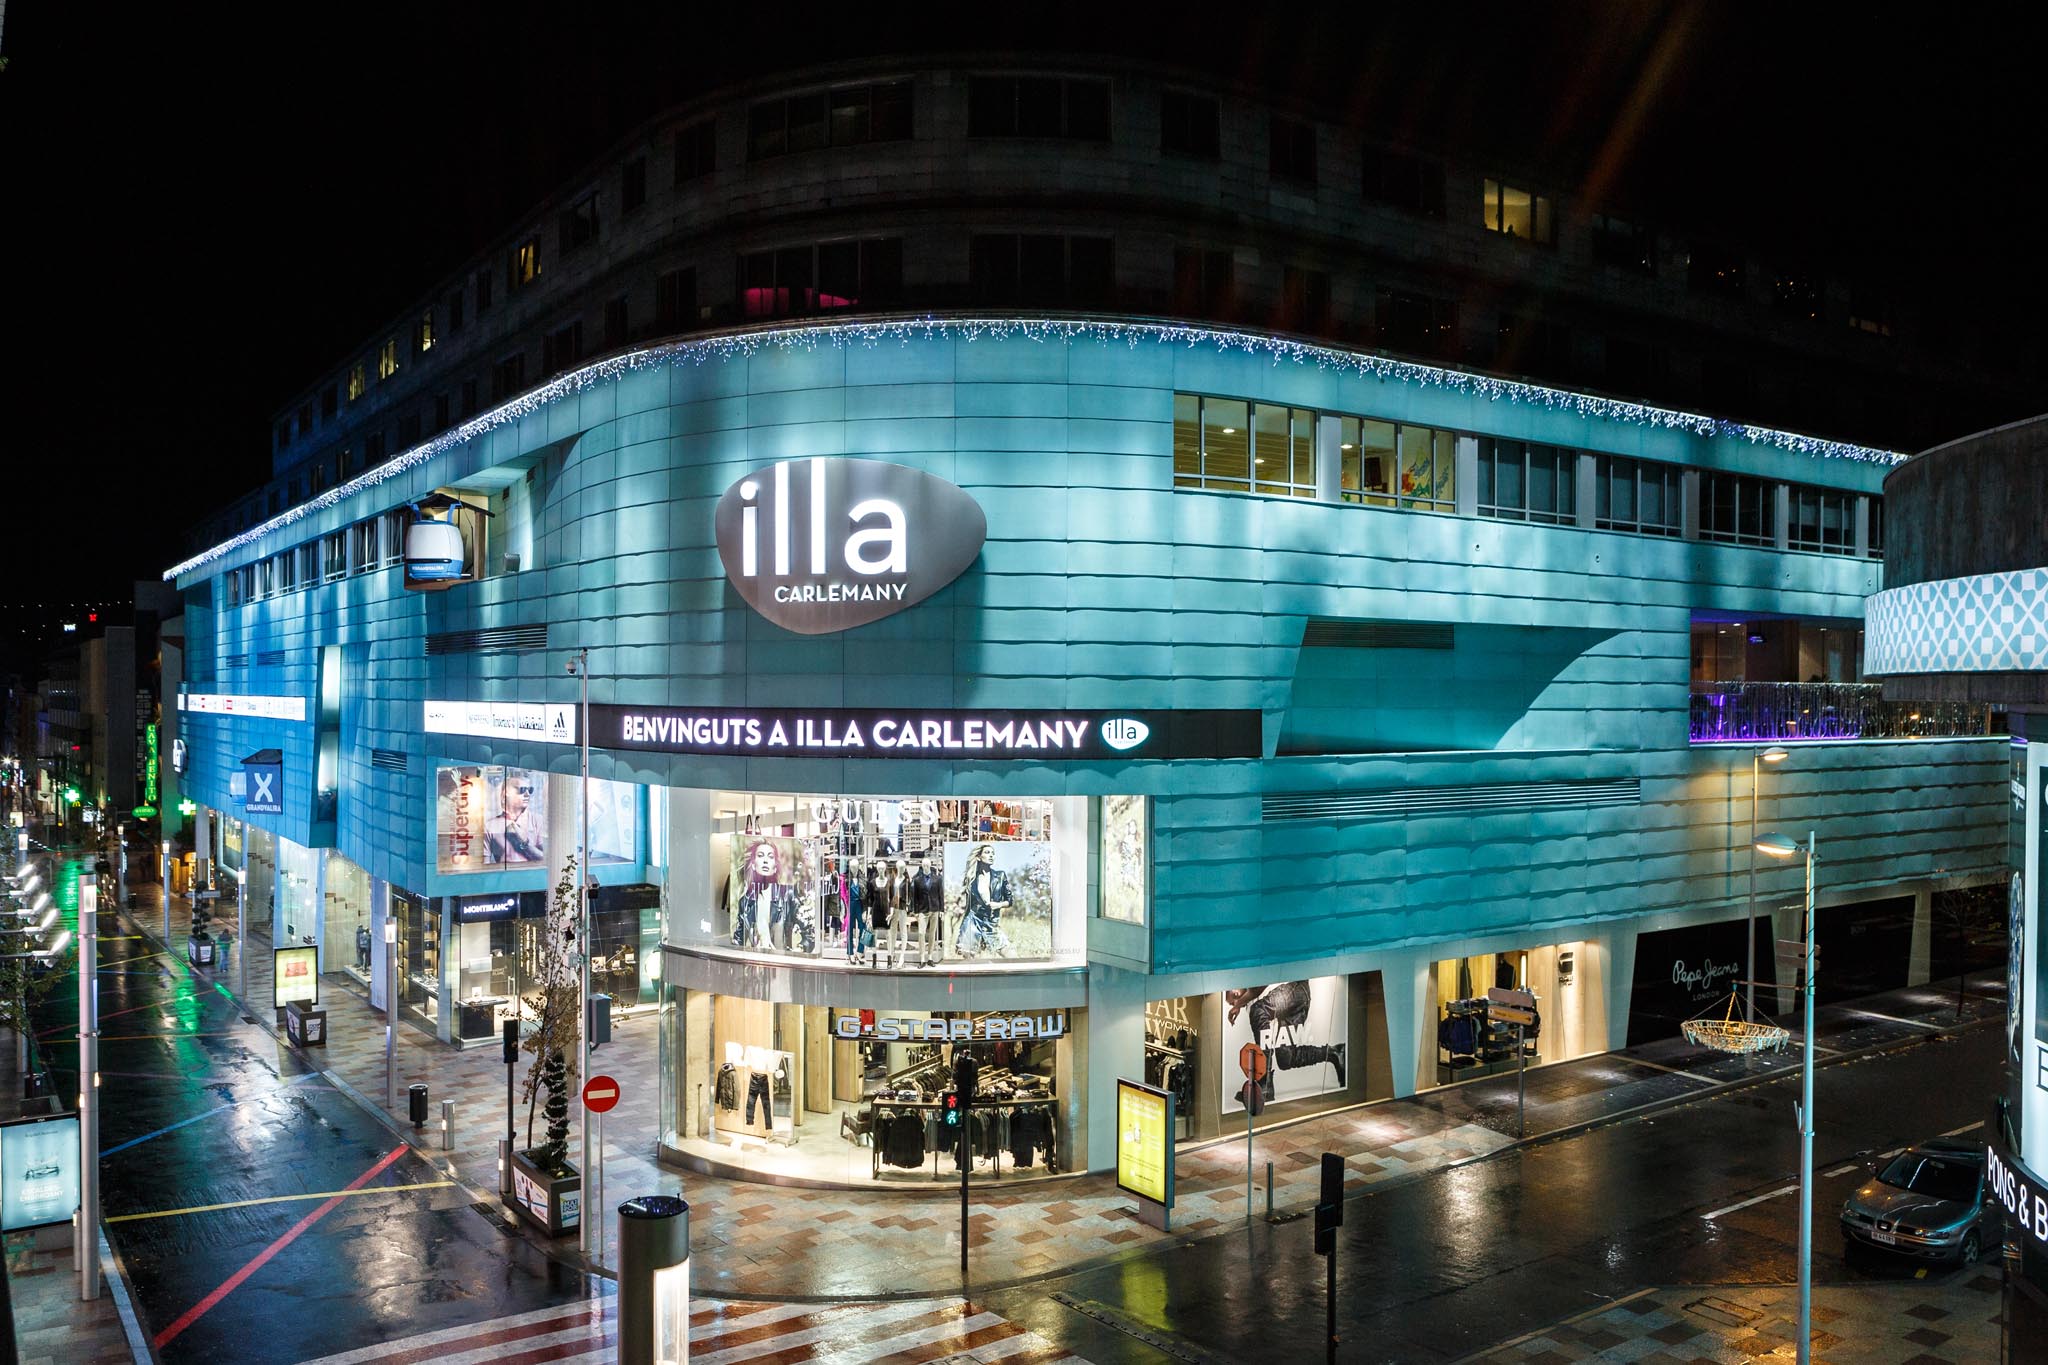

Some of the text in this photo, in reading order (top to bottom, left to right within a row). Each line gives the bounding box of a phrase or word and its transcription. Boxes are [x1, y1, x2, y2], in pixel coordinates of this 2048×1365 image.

[740, 457, 907, 576] illa
[774, 584, 907, 602] CARLEMANY
[623, 715, 1089, 749] BENVINGUTS A ILLA CARLEMANY
[1108, 719, 1136, 739] illa
[147, 725, 157, 801] CAVA BENITO
[246, 803, 281, 813] GRANDVALIRA
[811, 799, 939, 825] GUESS
[1672, 958, 1739, 991] Pepe Jeans
[1692, 990, 1720, 1001] LONDON
[837, 1014, 1063, 1041] G-STAR RAW
[1158, 1020, 1198, 1037] WOMEN
[1987, 1145, 2016, 1213] PONS
[2018, 1184, 2030, 1229] &
